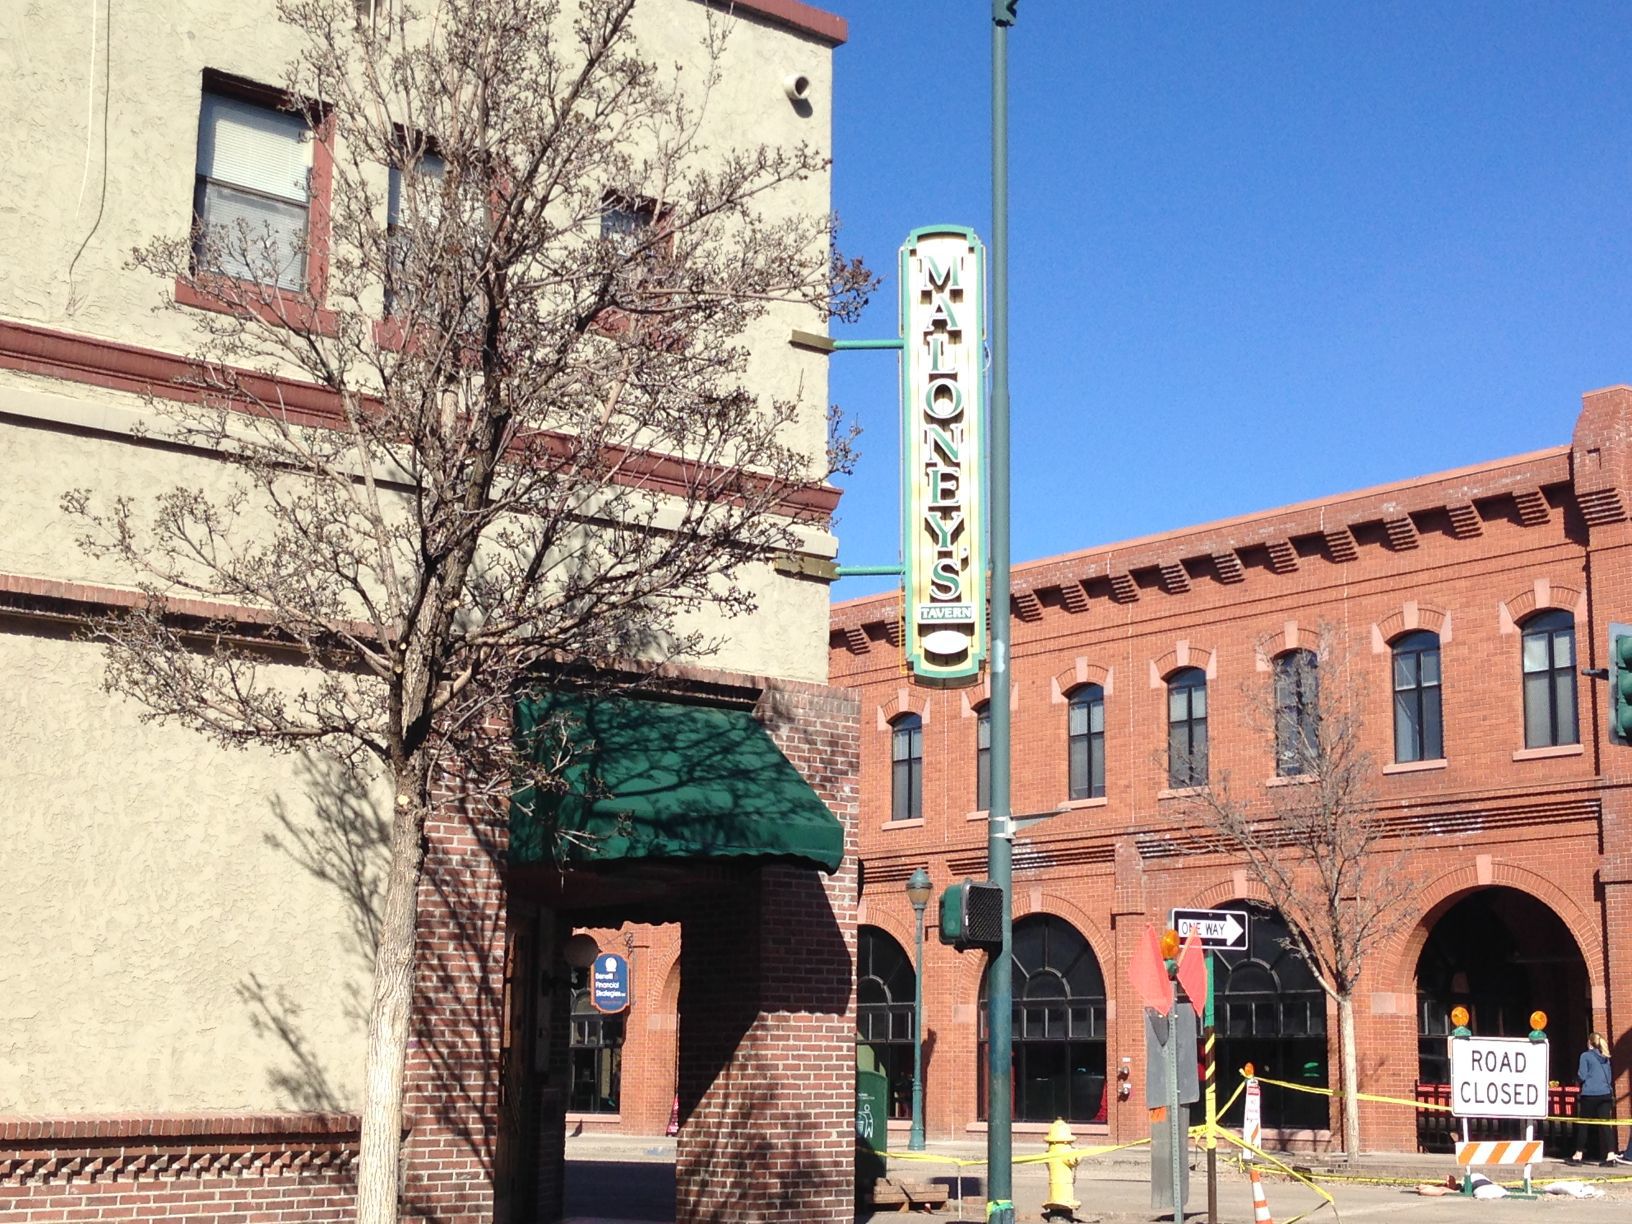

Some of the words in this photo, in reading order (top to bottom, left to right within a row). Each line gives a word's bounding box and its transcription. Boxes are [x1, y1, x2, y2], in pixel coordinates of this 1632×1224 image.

[919, 253, 969, 600] MALONEY'S
[920, 606, 972, 620] TAVERN
[1181, 921, 1202, 935] ONE
[1205, 922, 1225, 936] WAY
[595, 981, 620, 989] Financial
[1471, 1049, 1527, 1073] ROAD
[1460, 1081, 1539, 1106] CLOSED
